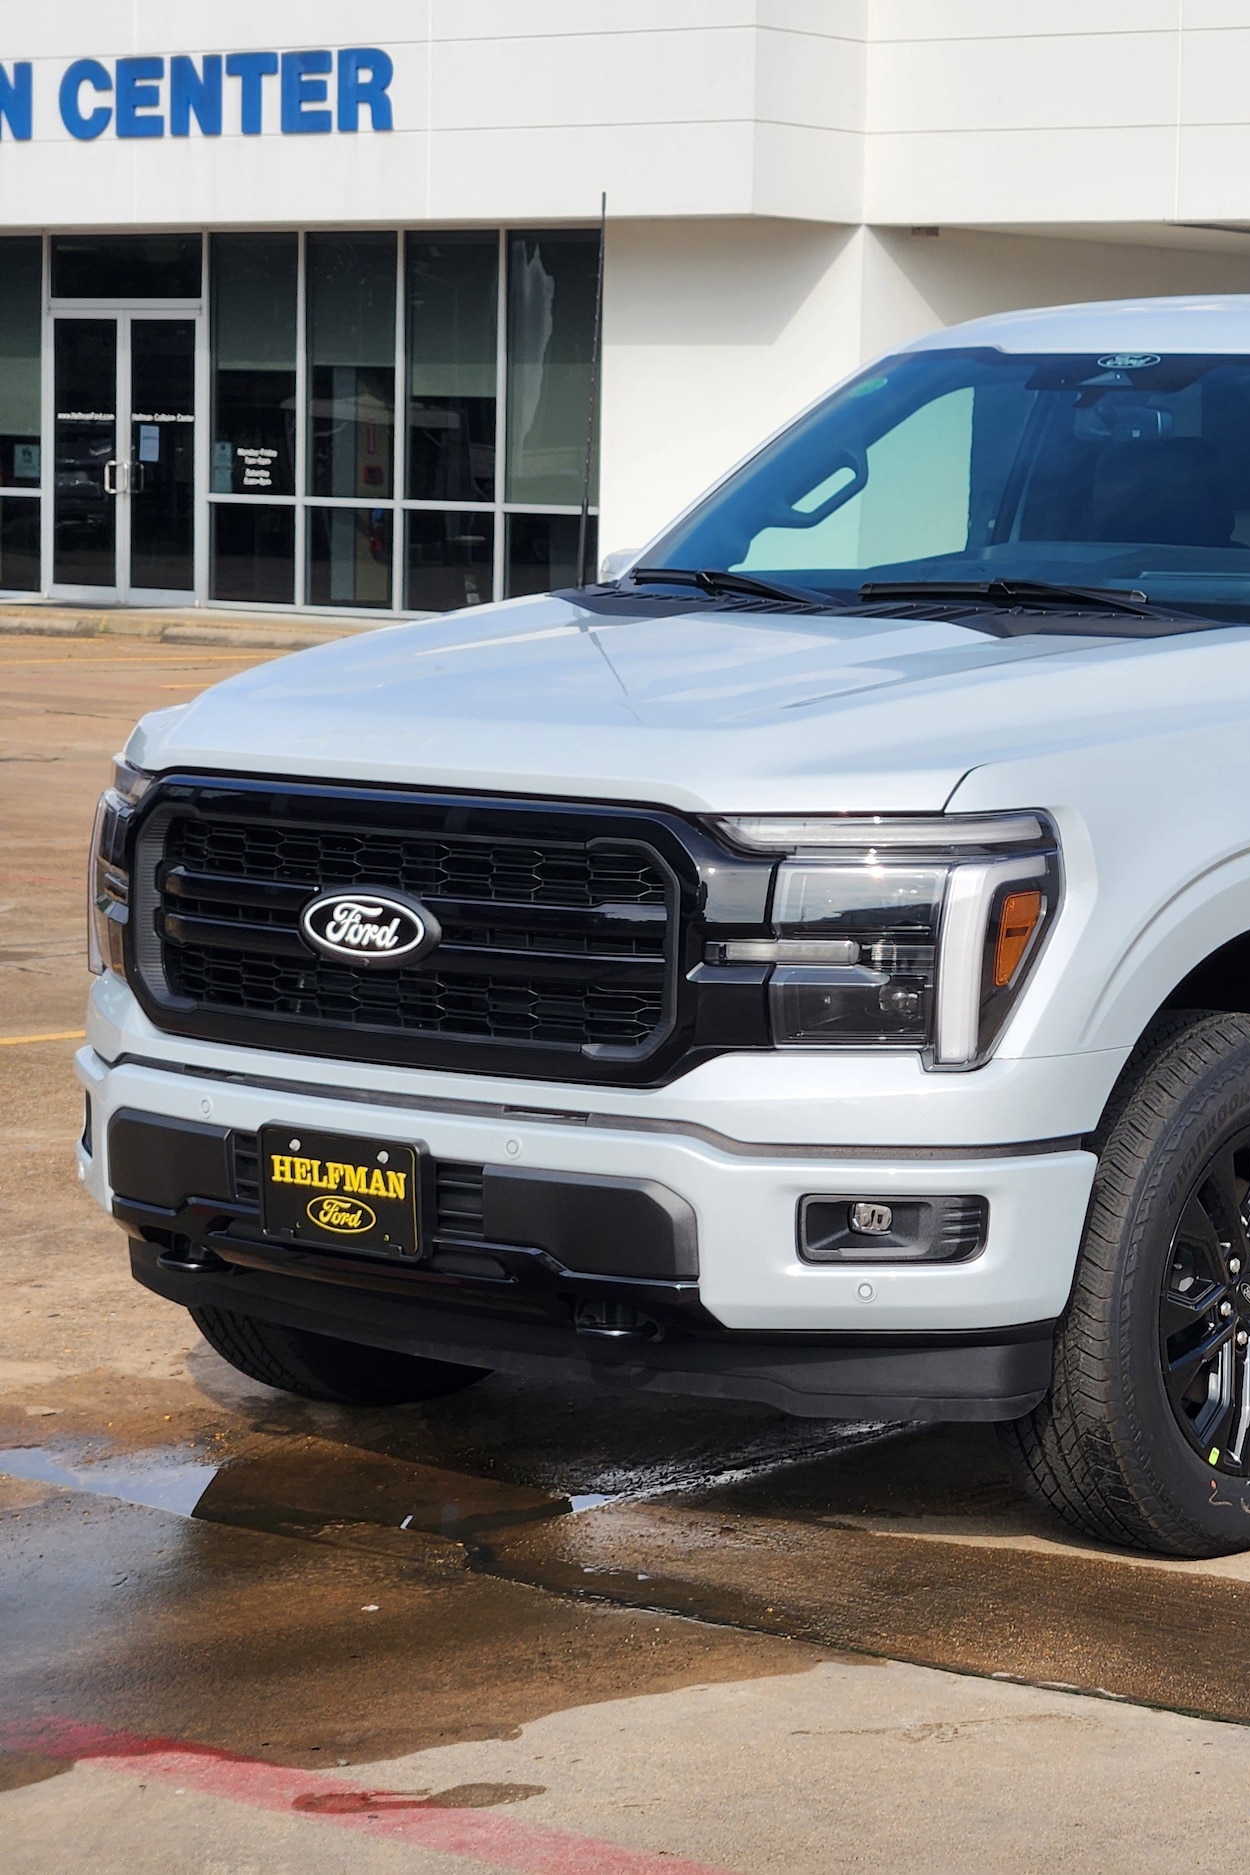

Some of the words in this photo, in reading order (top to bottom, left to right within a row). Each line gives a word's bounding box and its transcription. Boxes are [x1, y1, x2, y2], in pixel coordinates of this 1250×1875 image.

[59, 47, 394, 141] CENTER
[1105, 353, 1151, 367] Ford
[326, 902, 401, 949] Ford
[271, 1155, 406, 1200] HELFMAN
[318, 1199, 363, 1228] Ford
